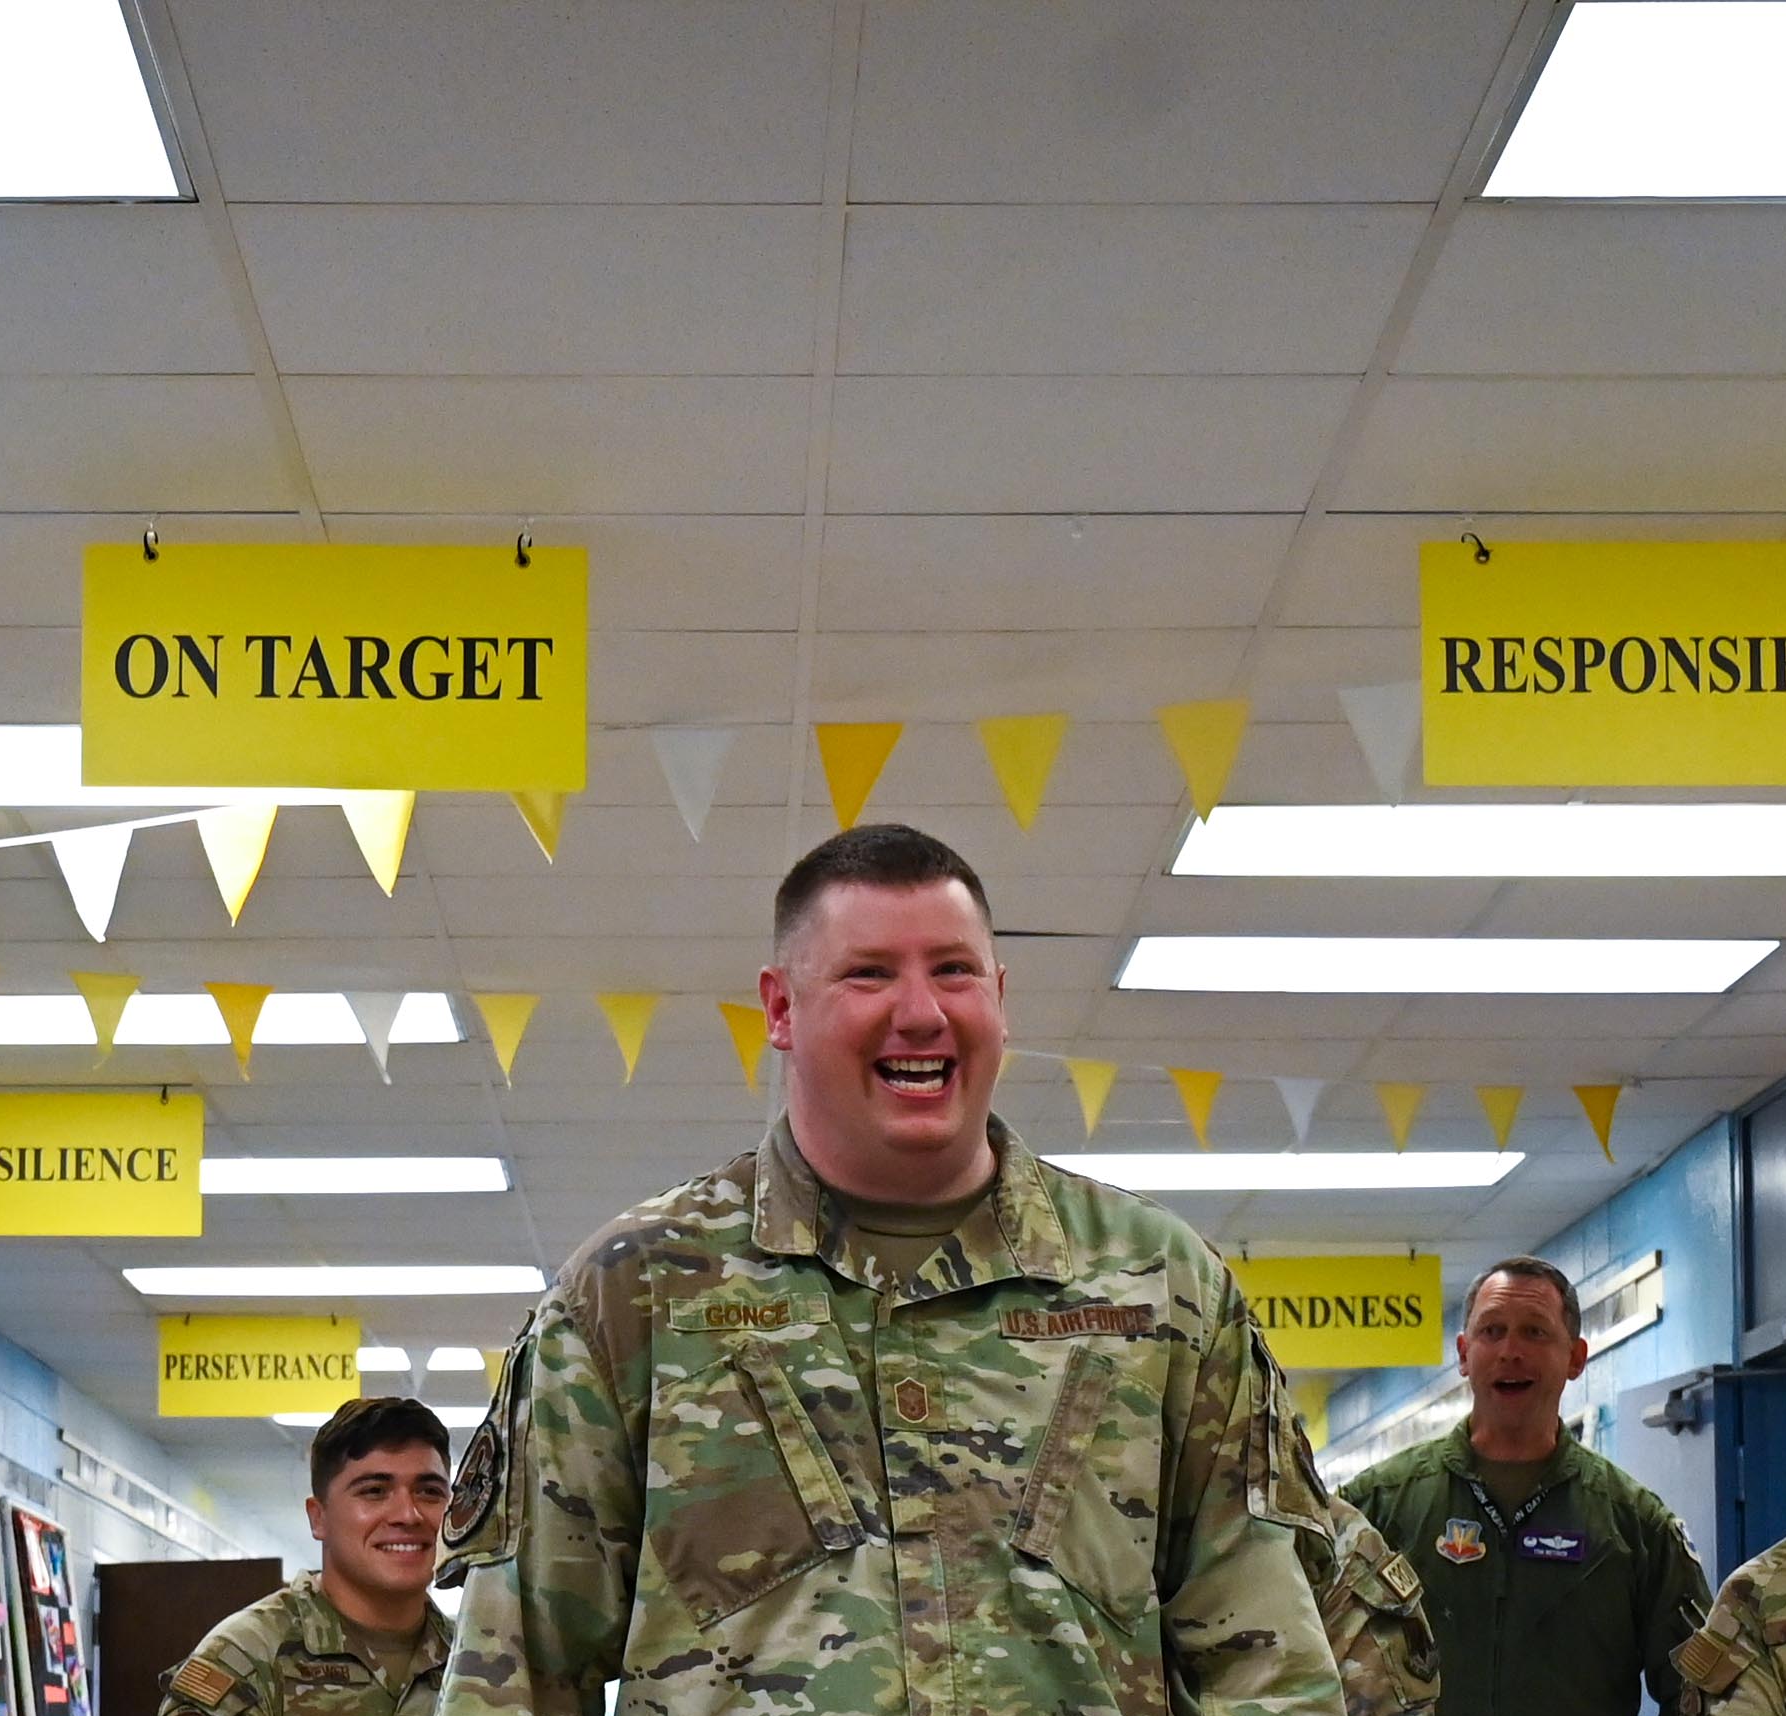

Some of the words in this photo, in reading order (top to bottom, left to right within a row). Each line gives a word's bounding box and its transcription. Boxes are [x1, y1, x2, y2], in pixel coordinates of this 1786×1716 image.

[113, 633, 223, 701] ON
[256, 634, 554, 701] TARGET
[704, 1302, 789, 1327] GONCE
[1006, 1310, 1046, 1337] U.S.
[1047, 1309, 1084, 1337] AIR
[1084, 1305, 1153, 1335] FORCE
[164, 1353, 355, 1382] PERSEVERANCE
